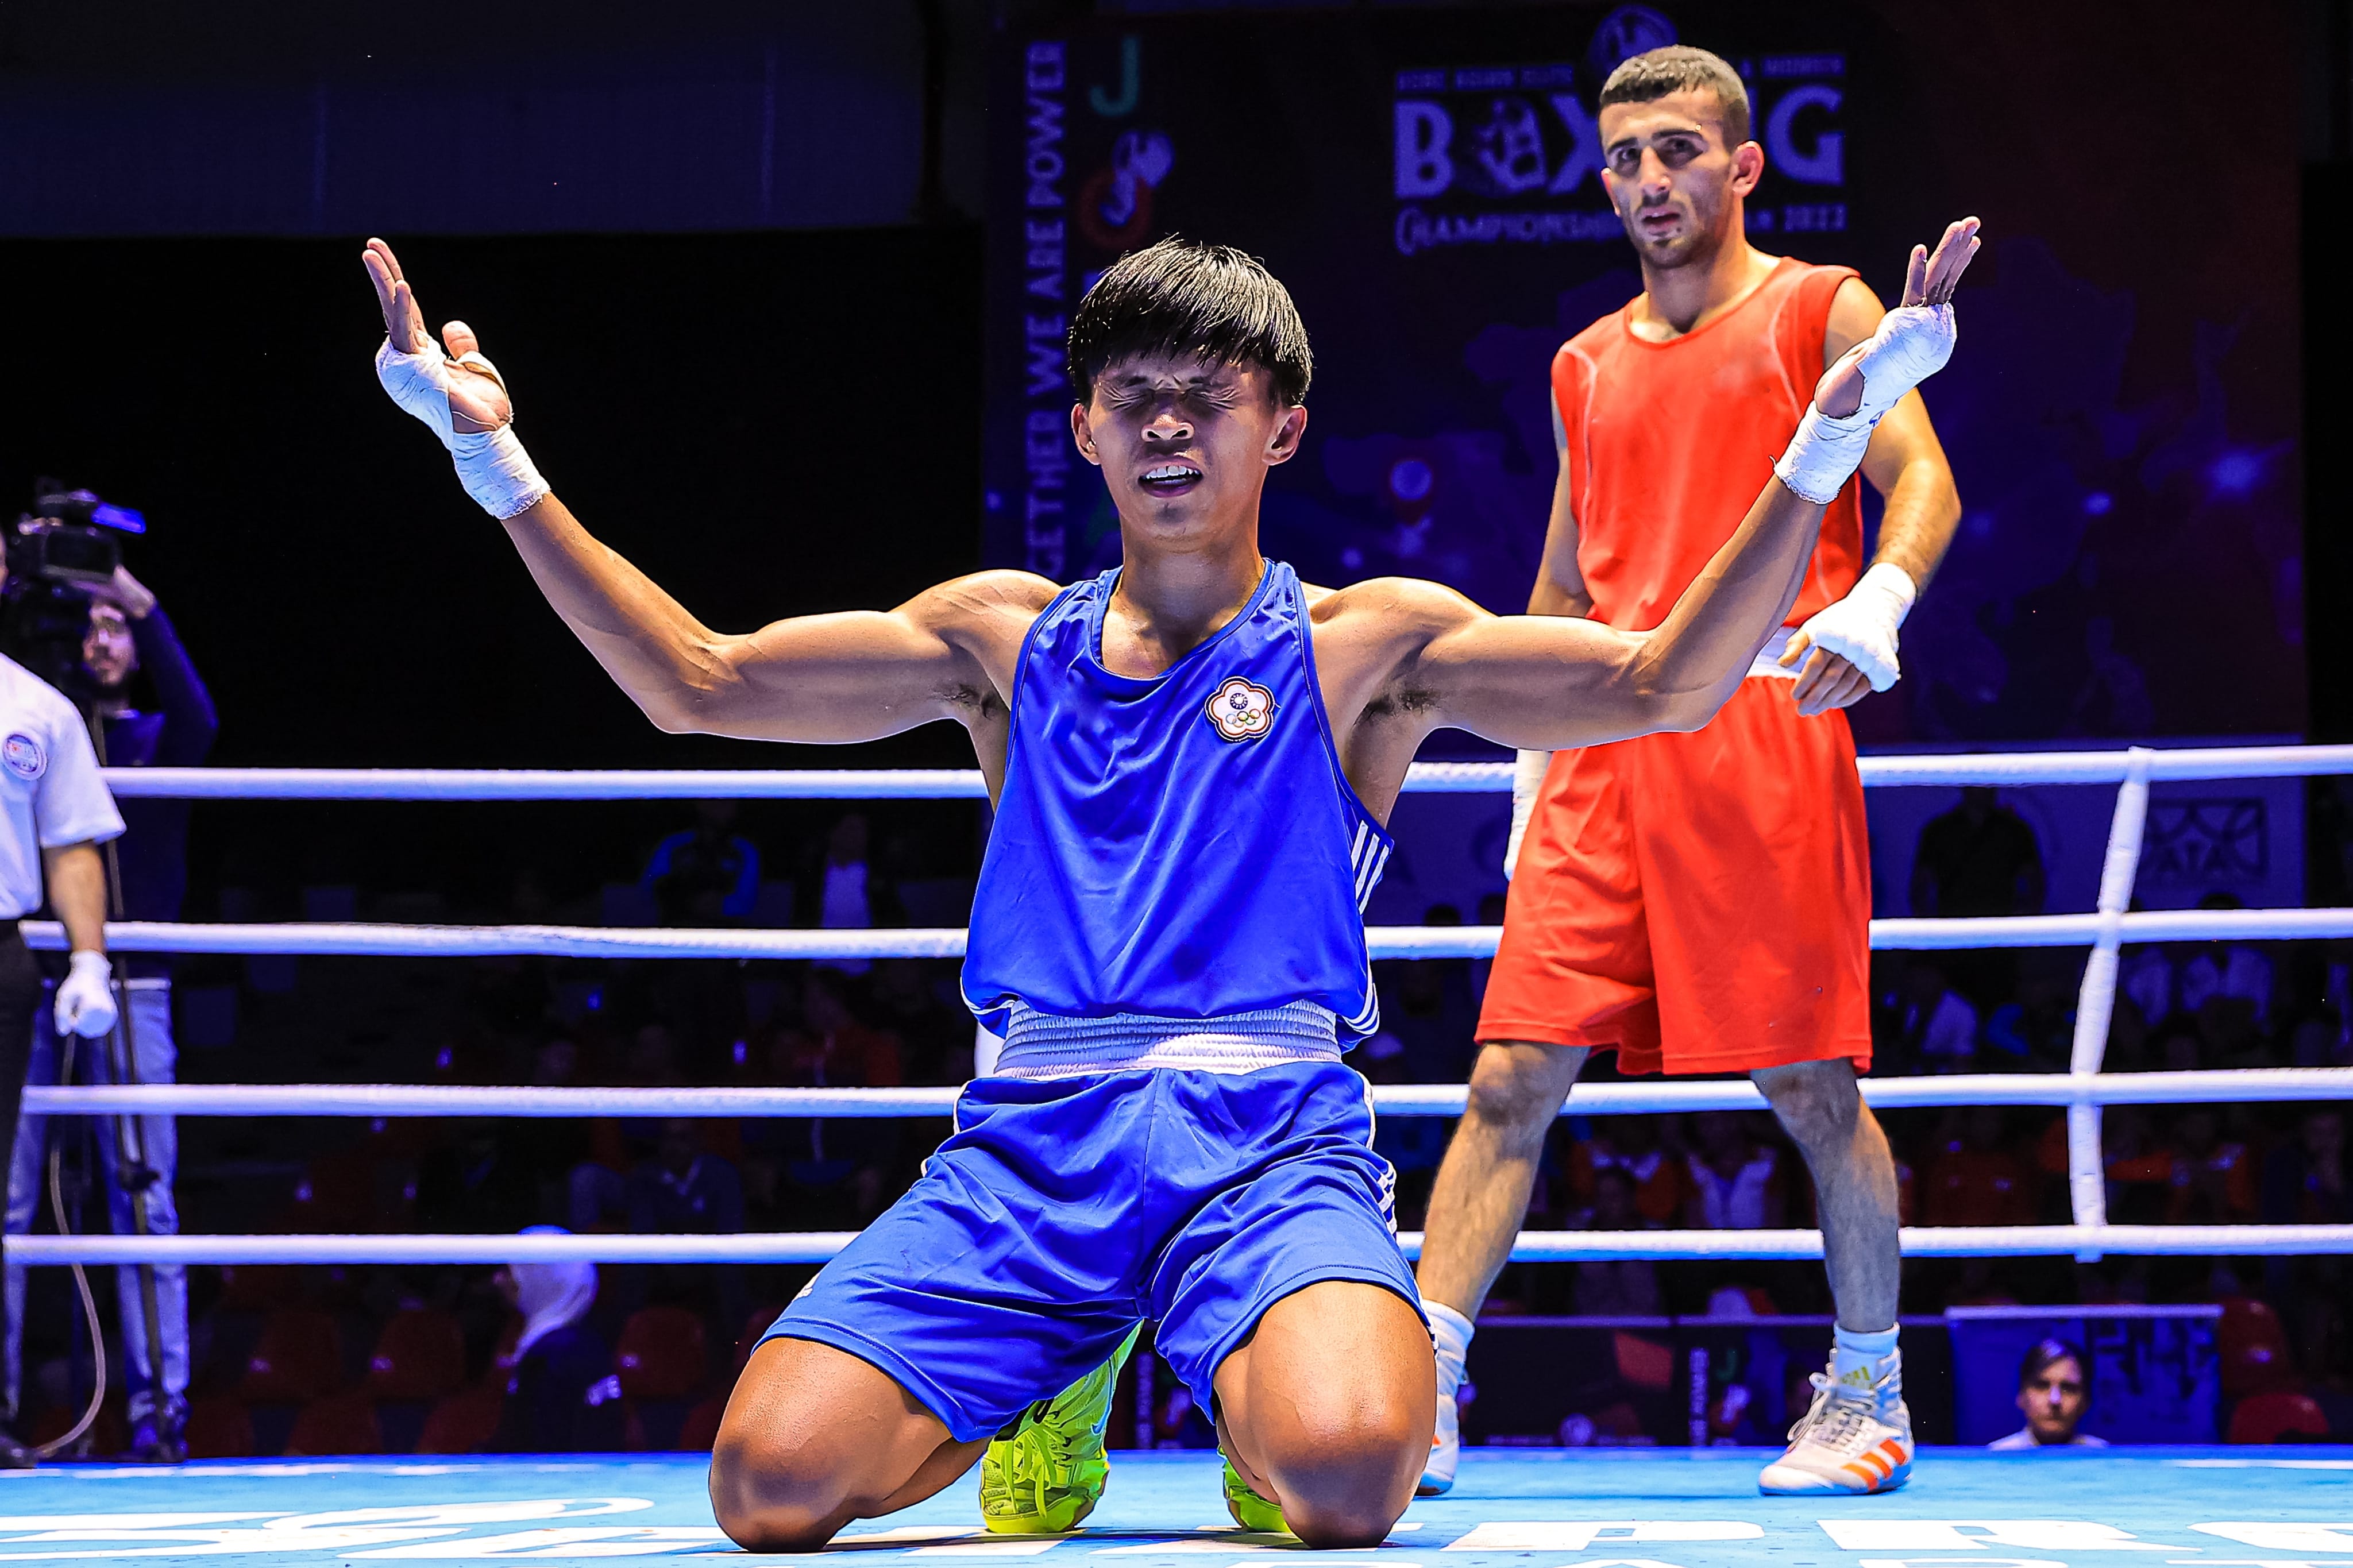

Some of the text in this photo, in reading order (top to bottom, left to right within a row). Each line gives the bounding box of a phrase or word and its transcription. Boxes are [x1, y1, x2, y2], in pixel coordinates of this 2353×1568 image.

[1025, 40, 1066, 208] POWER
[1025, 218, 1066, 300] ARE
[1025, 312, 1065, 396] WE
